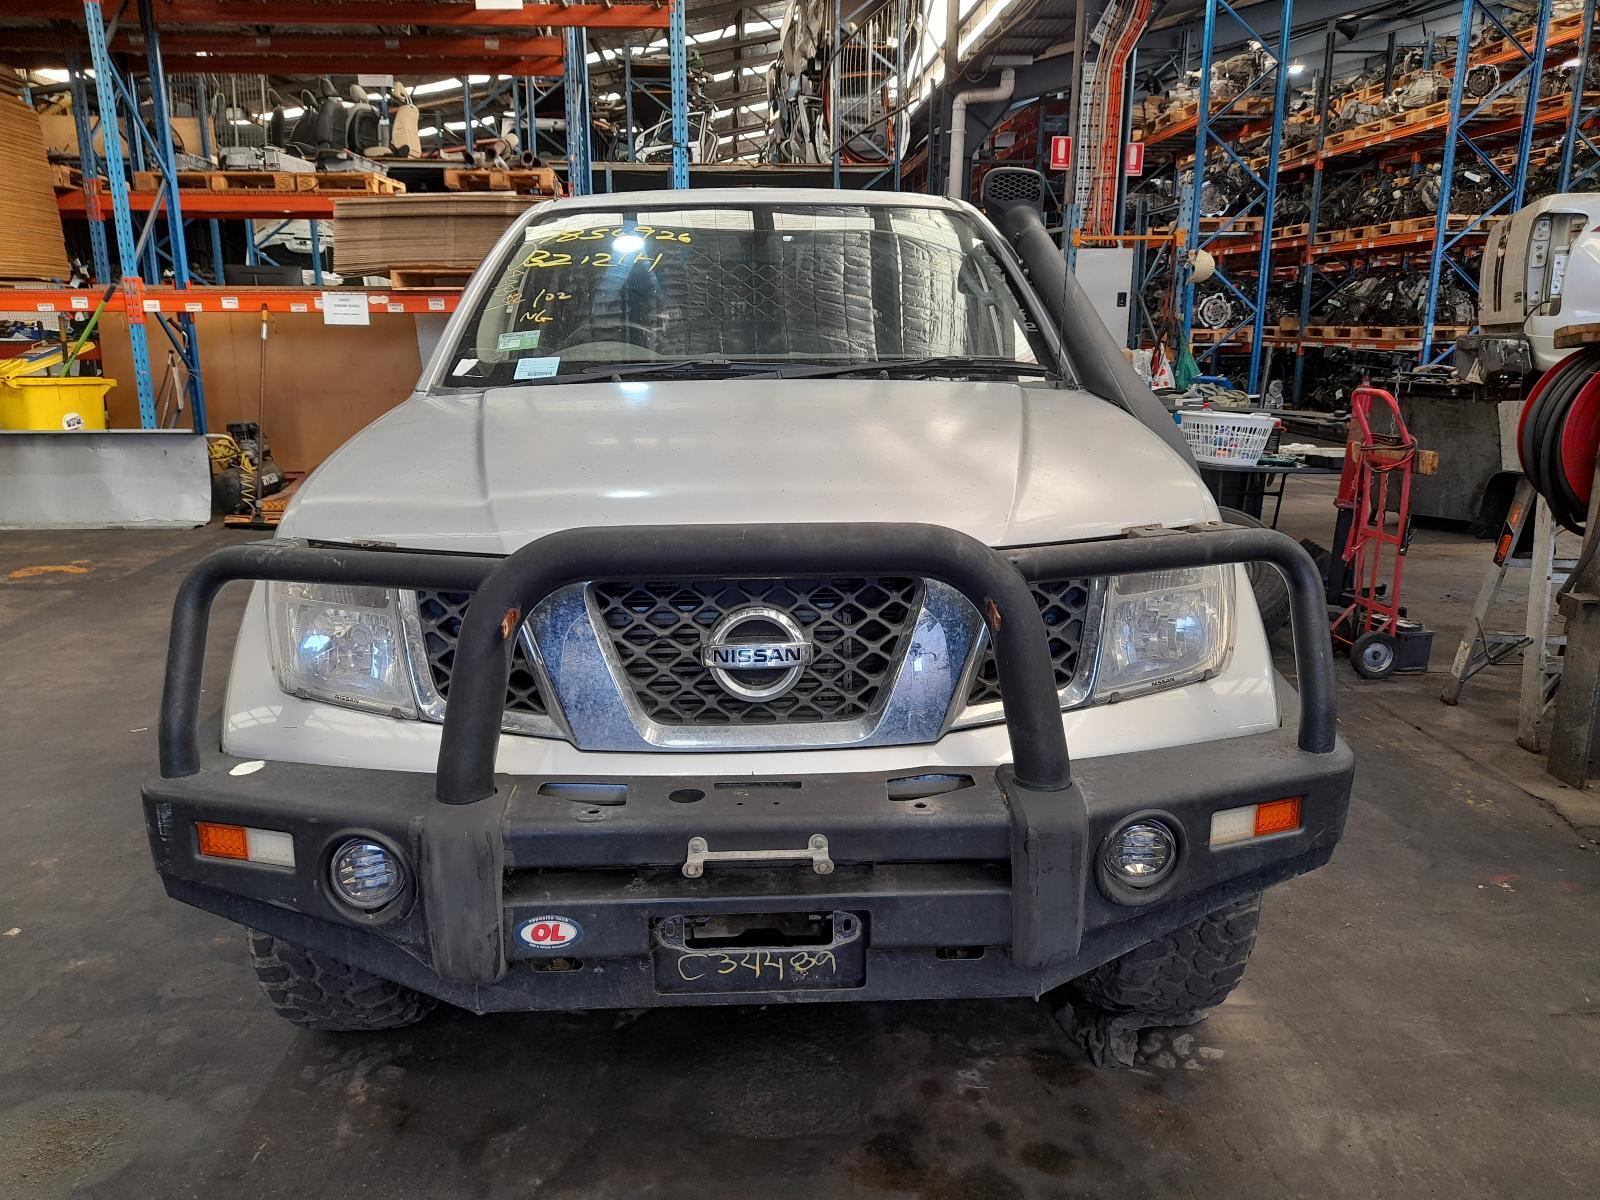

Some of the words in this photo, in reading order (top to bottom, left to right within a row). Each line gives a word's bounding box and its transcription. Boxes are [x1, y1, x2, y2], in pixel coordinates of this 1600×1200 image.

[713, 647, 801, 663] NISSAN
[1151, 676, 1175, 687] NISSAN
[335, 694, 359, 704] NISSAN
[531, 923, 566, 942] OL
